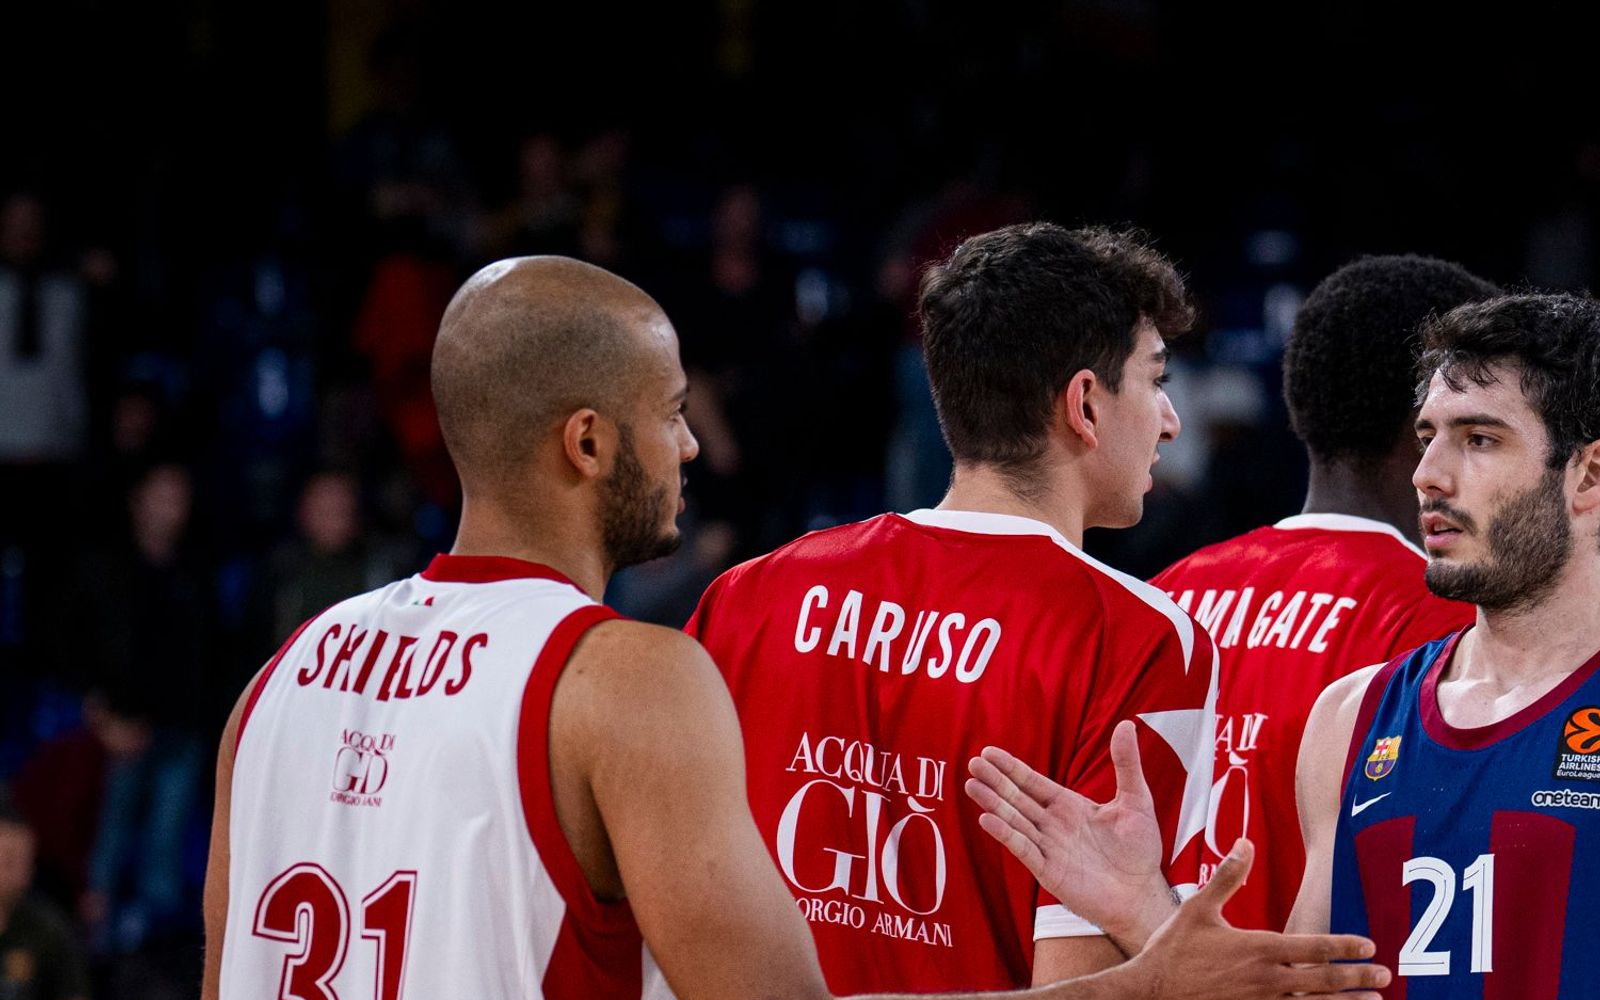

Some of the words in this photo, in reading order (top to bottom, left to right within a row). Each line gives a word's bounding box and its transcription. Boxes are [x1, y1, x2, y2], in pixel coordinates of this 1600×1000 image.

[794, 585, 1001, 684] CARUSO
[1167, 586, 1357, 653] MAGATE
[785, 731, 909, 795] ACQUA
[916, 757, 947, 801] DI
[776, 779, 947, 915] GIÒ
[796, 897, 865, 929] ORGIO
[871, 912, 953, 947] ARMANI
[1398, 854, 1495, 976] 21
